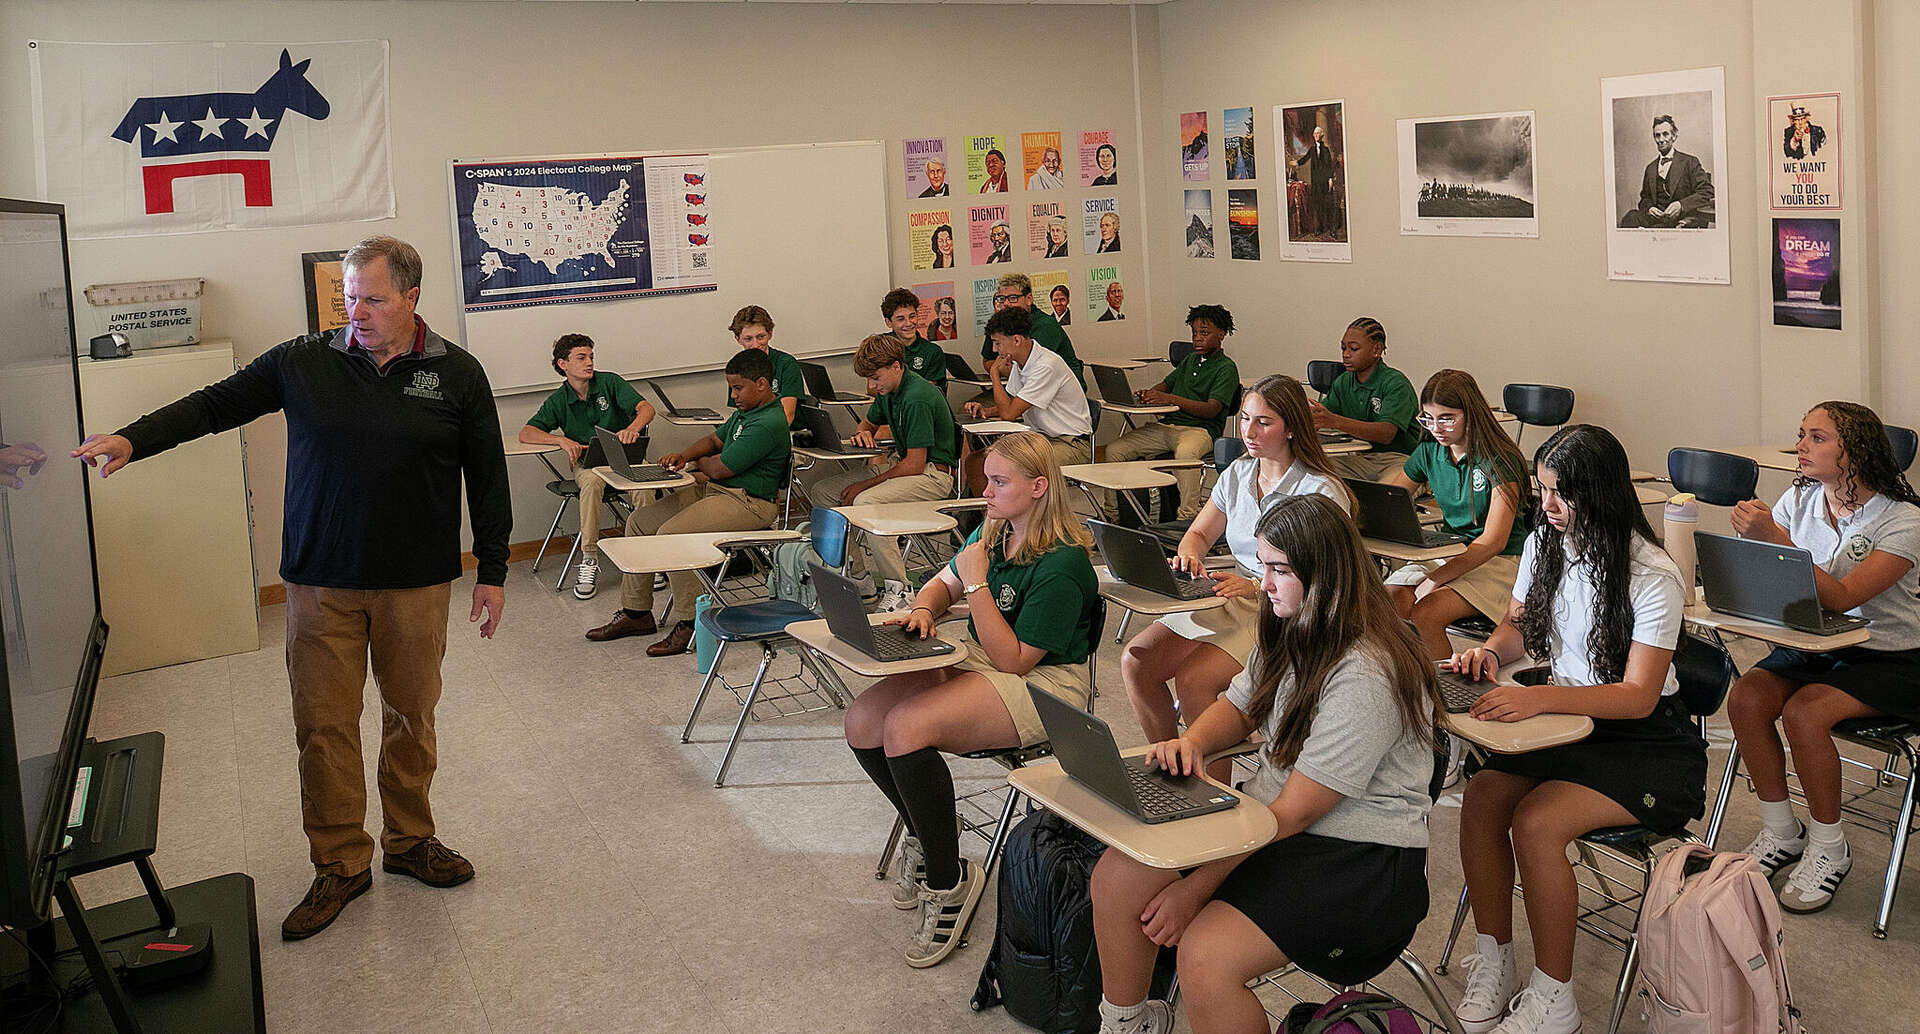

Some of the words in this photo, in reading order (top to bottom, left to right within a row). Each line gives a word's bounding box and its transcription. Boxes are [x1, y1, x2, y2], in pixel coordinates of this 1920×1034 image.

[973, 137, 995, 150] HOPE
[1084, 132, 1109, 145] COURAGE
[906, 139, 943, 154] INNOVATION
[514, 166, 536, 176] 2024
[538, 165, 576, 175] Electoral
[578, 165, 611, 174] College
[612, 164, 632, 173] Map
[1783, 163, 1798, 173] WE
[1800, 162, 1826, 172] WANT
[1796, 174, 1814, 183] YOU
[1792, 184, 1803, 194] TO
[1806, 183, 1818, 194] DO
[1086, 199, 1114, 212] SERVICE
[1780, 194, 1805, 205] YOUR
[1807, 194, 1830, 205] BEST
[972, 207, 1005, 222] DIGNITY
[1032, 203, 1059, 217] EQUALITY
[910, 211, 950, 227] COMPASSION
[1786, 240, 1830, 250] DREAM
[1091, 267, 1116, 280] VISION
[974, 278, 998, 292] INSPIRA
[111, 312, 147, 322] UNITED
[149, 308, 187, 318] STATES
[108, 321, 147, 332] POSTAL
[150, 317, 192, 328] SERVICE
